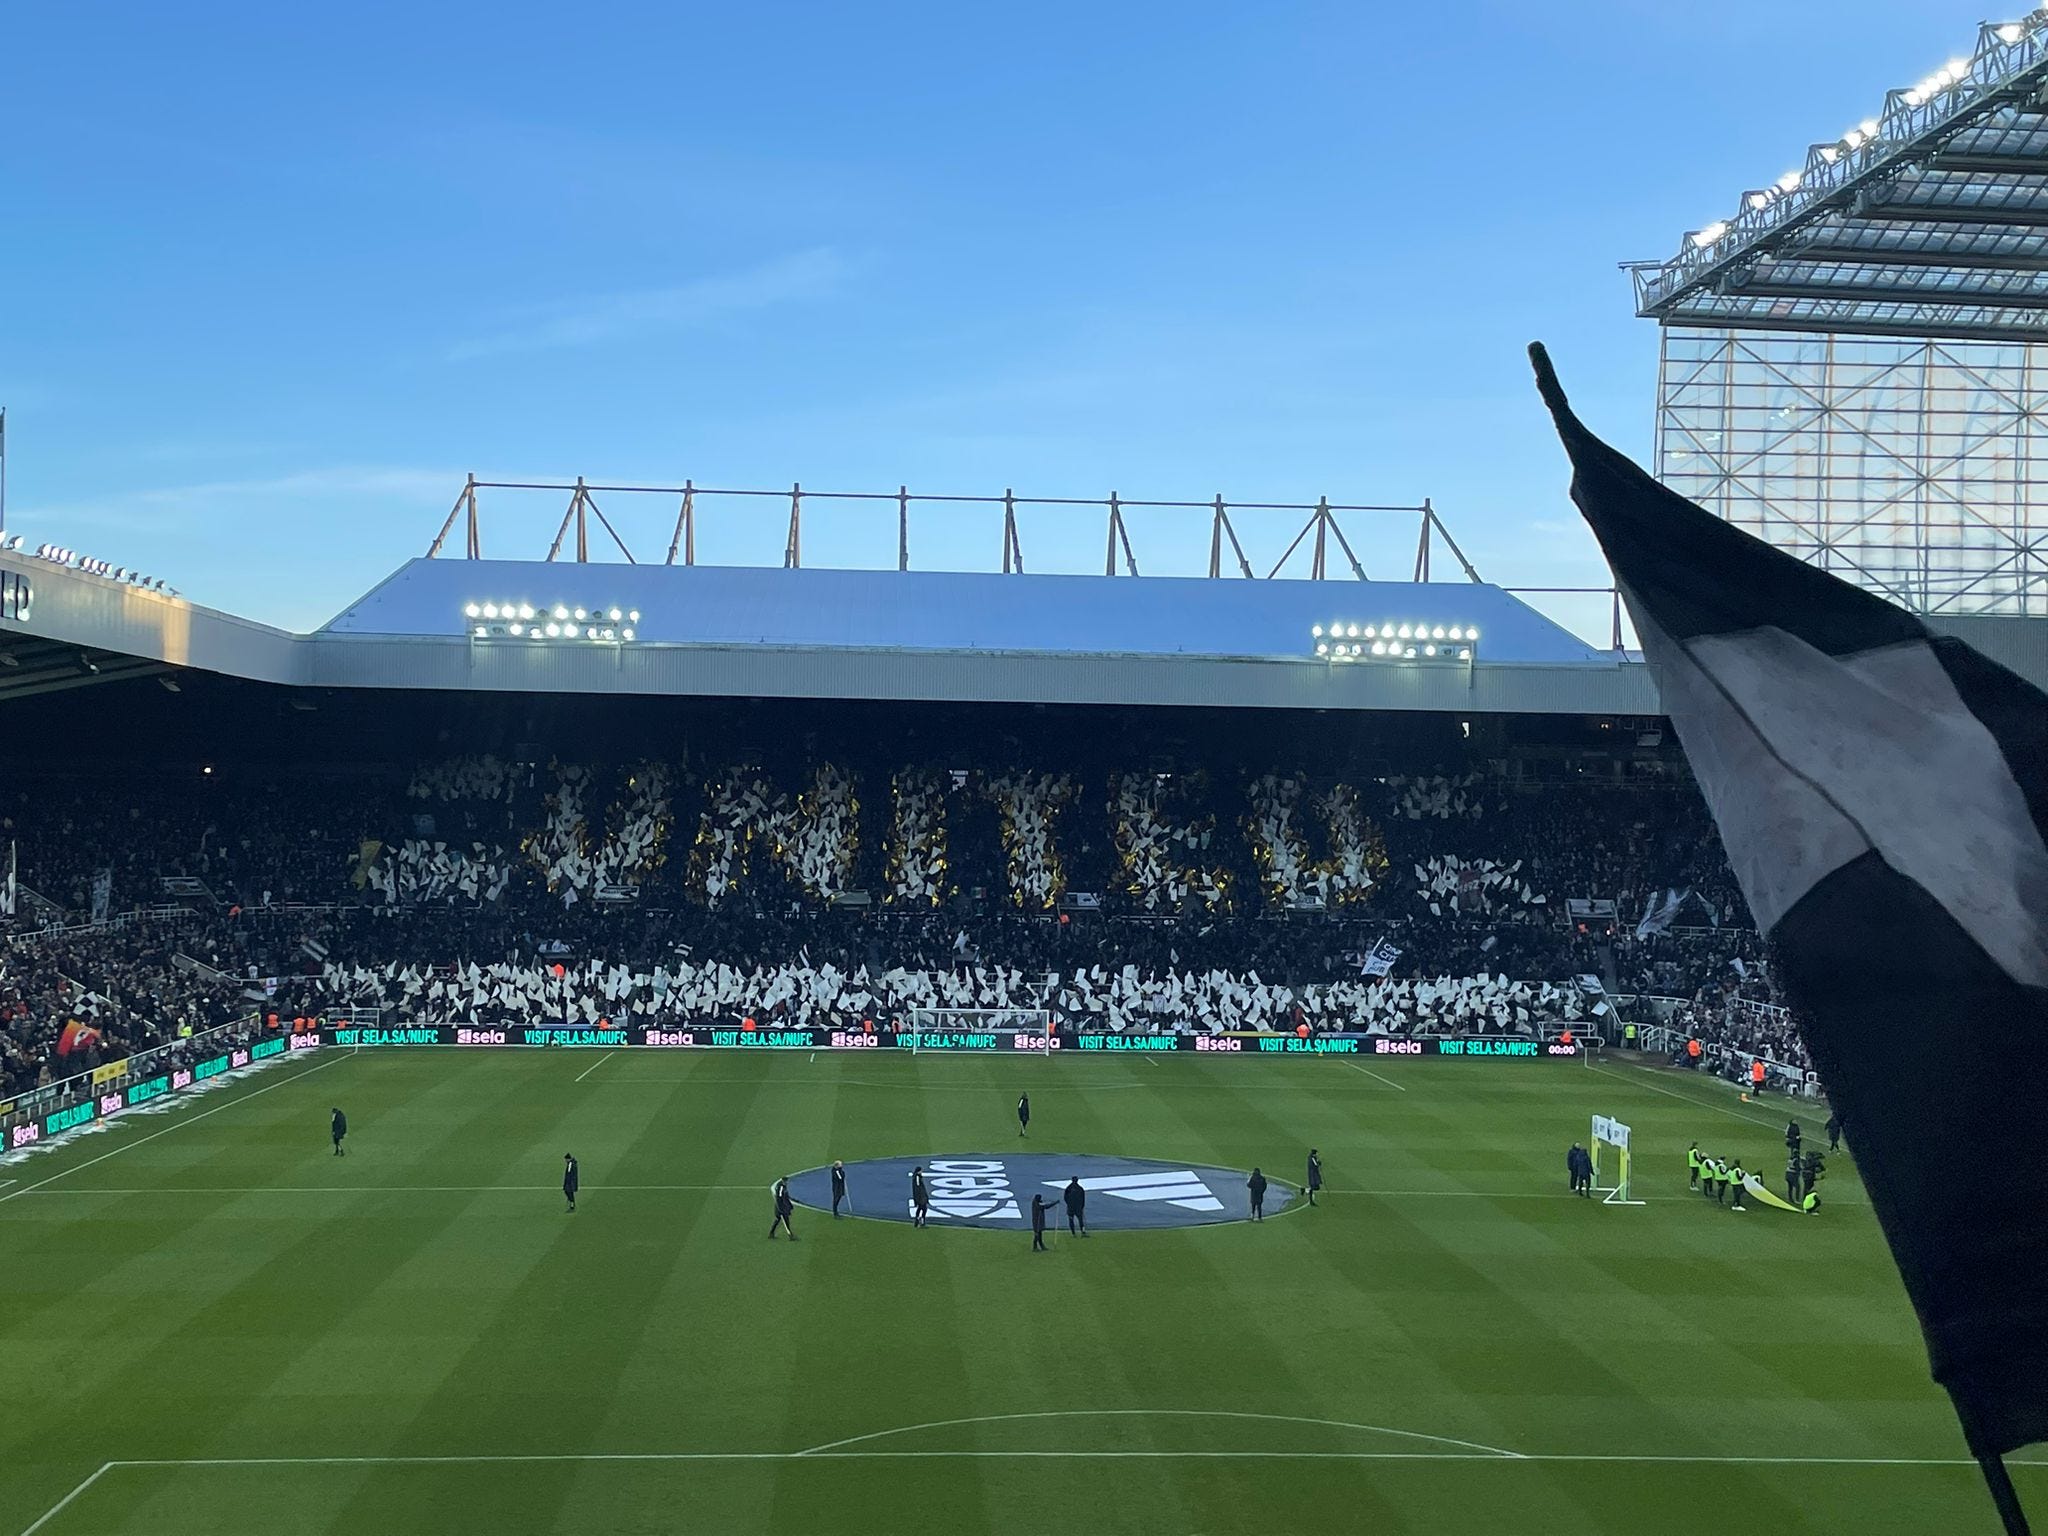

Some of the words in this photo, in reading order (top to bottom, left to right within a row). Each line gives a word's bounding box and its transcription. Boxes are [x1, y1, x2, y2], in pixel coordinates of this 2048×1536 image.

[297, 1032, 319, 1048] sela
[335, 1029, 359, 1044] VISIT
[362, 1029, 439, 1044] SELA.SA/NUFC
[471, 1029, 505, 1044] sela
[524, 1030, 551, 1045] VISIT
[553, 1030, 628, 1045] SELA.SA/NUFC
[660, 1030, 693, 1045] sela
[711, 1032, 738, 1046] VISIT
[740, 1032, 813, 1047] SELA.SA/NUFC
[845, 1032, 878, 1047] sela
[896, 1033, 921, 1048] VIST
[1029, 1035, 1061, 1049] sea
[1078, 1036, 1104, 1050] VISIT
[1106, 1036, 1178, 1051] SELA.SA/NUFC
[1210, 1037, 1241, 1051] sela
[1258, 1038, 1285, 1052] VISIT
[1286, 1038, 1358, 1053] SELA.SA/NUFC
[1390, 1040, 1422, 1054] sela
[1439, 1040, 1465, 1055] VISIT
[1466, 1041, 1538, 1056] SELA.SA/NUFC
[1548, 1045, 1575, 1055] 00:00
[908, 1160, 1014, 1199] sela
